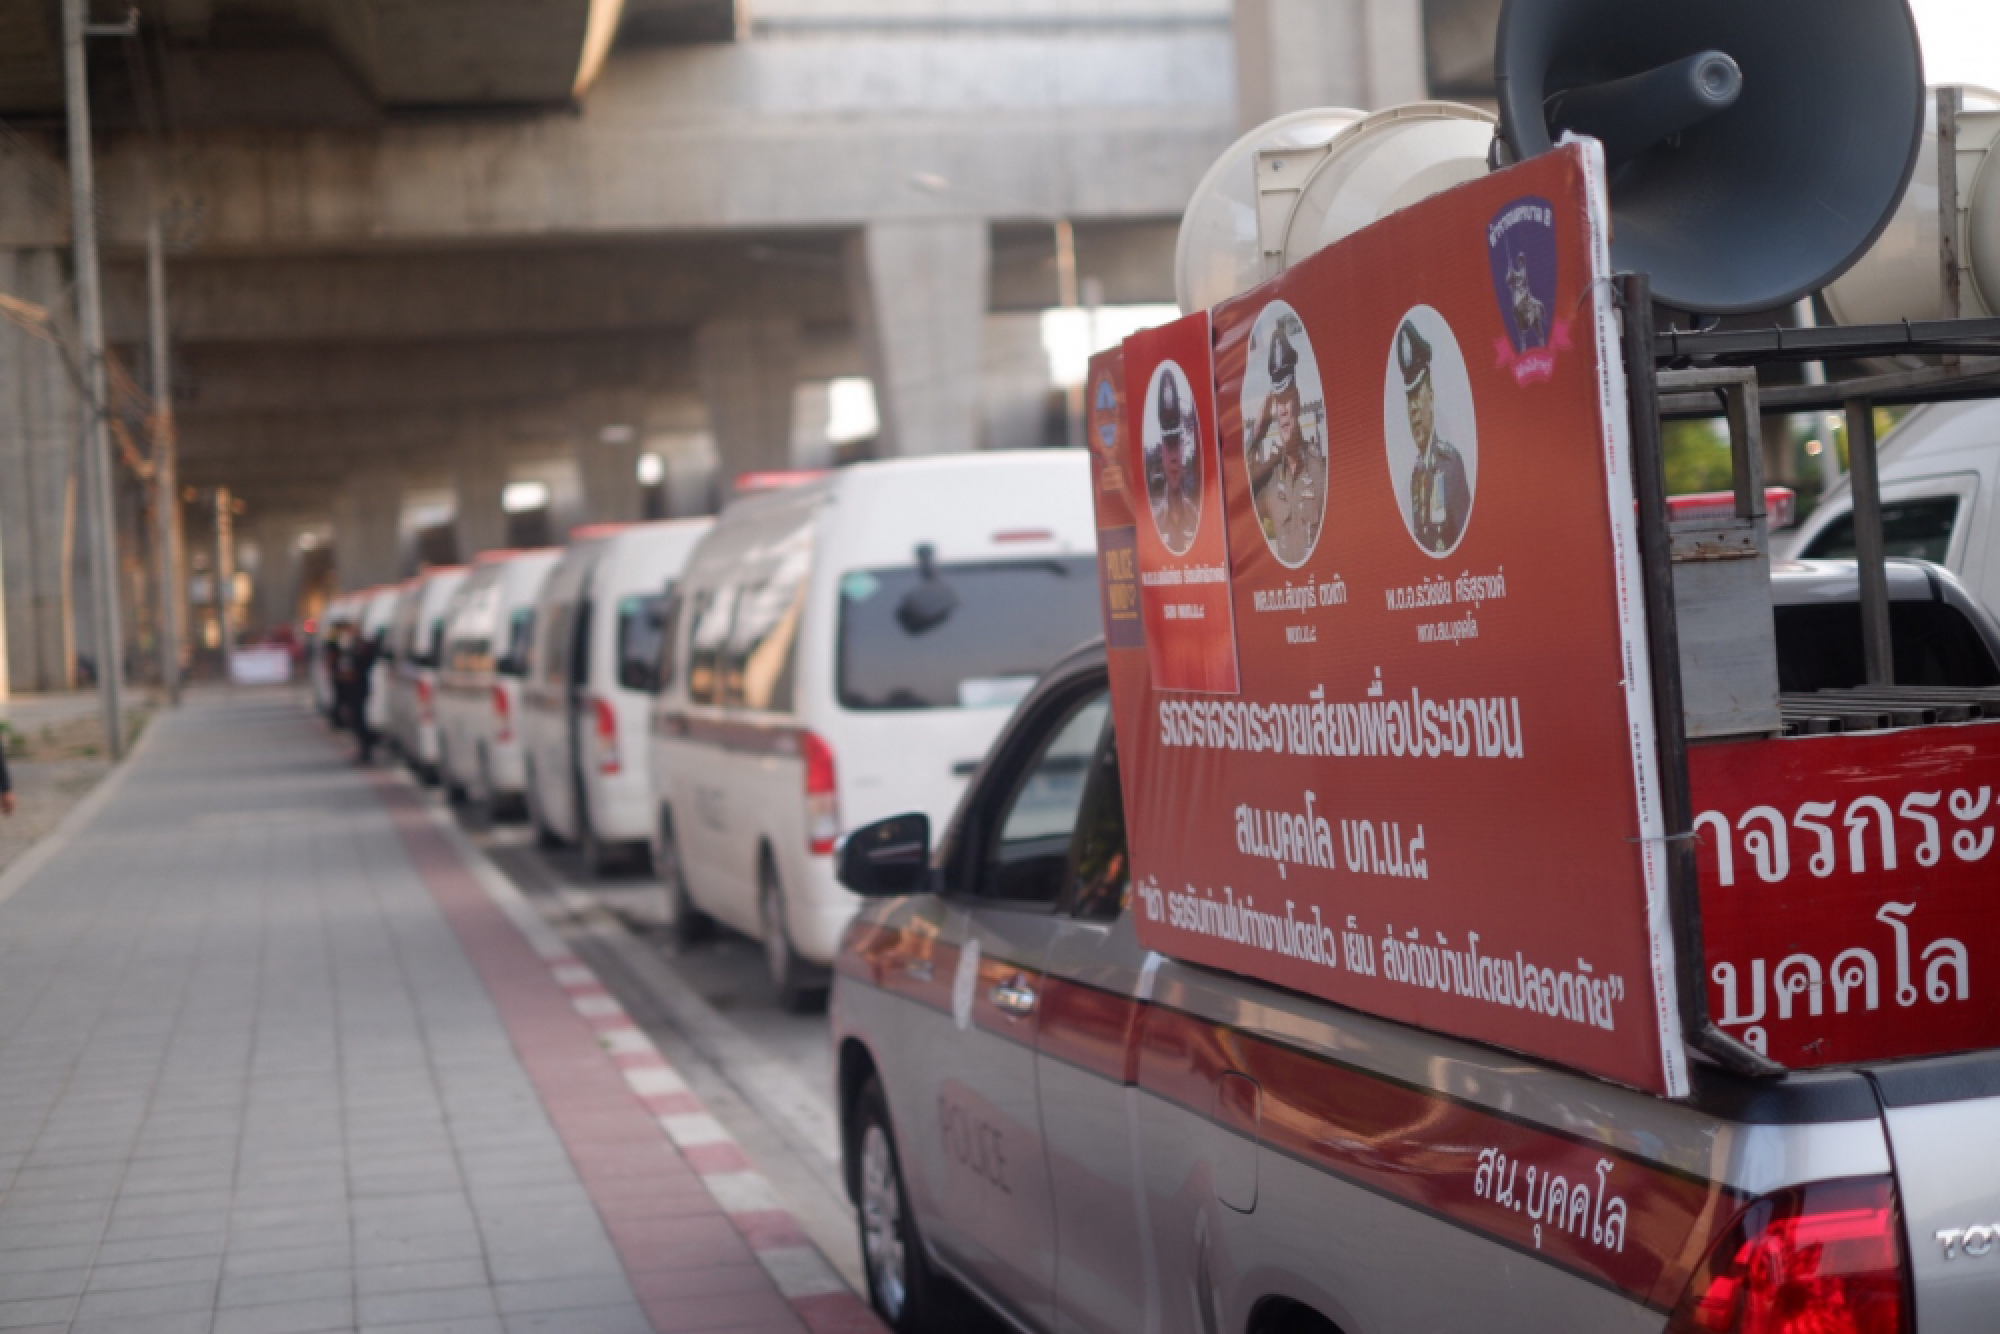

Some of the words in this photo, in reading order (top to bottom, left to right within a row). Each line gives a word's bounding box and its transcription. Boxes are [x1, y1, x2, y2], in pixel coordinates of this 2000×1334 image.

[1159, 666, 1524, 759] รถจราจรกระจายเสียงเพื่อประชาชน
[1235, 790, 1334, 880] สน.บุคคโล
[1693, 785, 2000, 886] าจรกระ
[1342, 915, 1377, 977] เย็น
[1474, 1147, 1627, 1253] สน.บุคคโล
